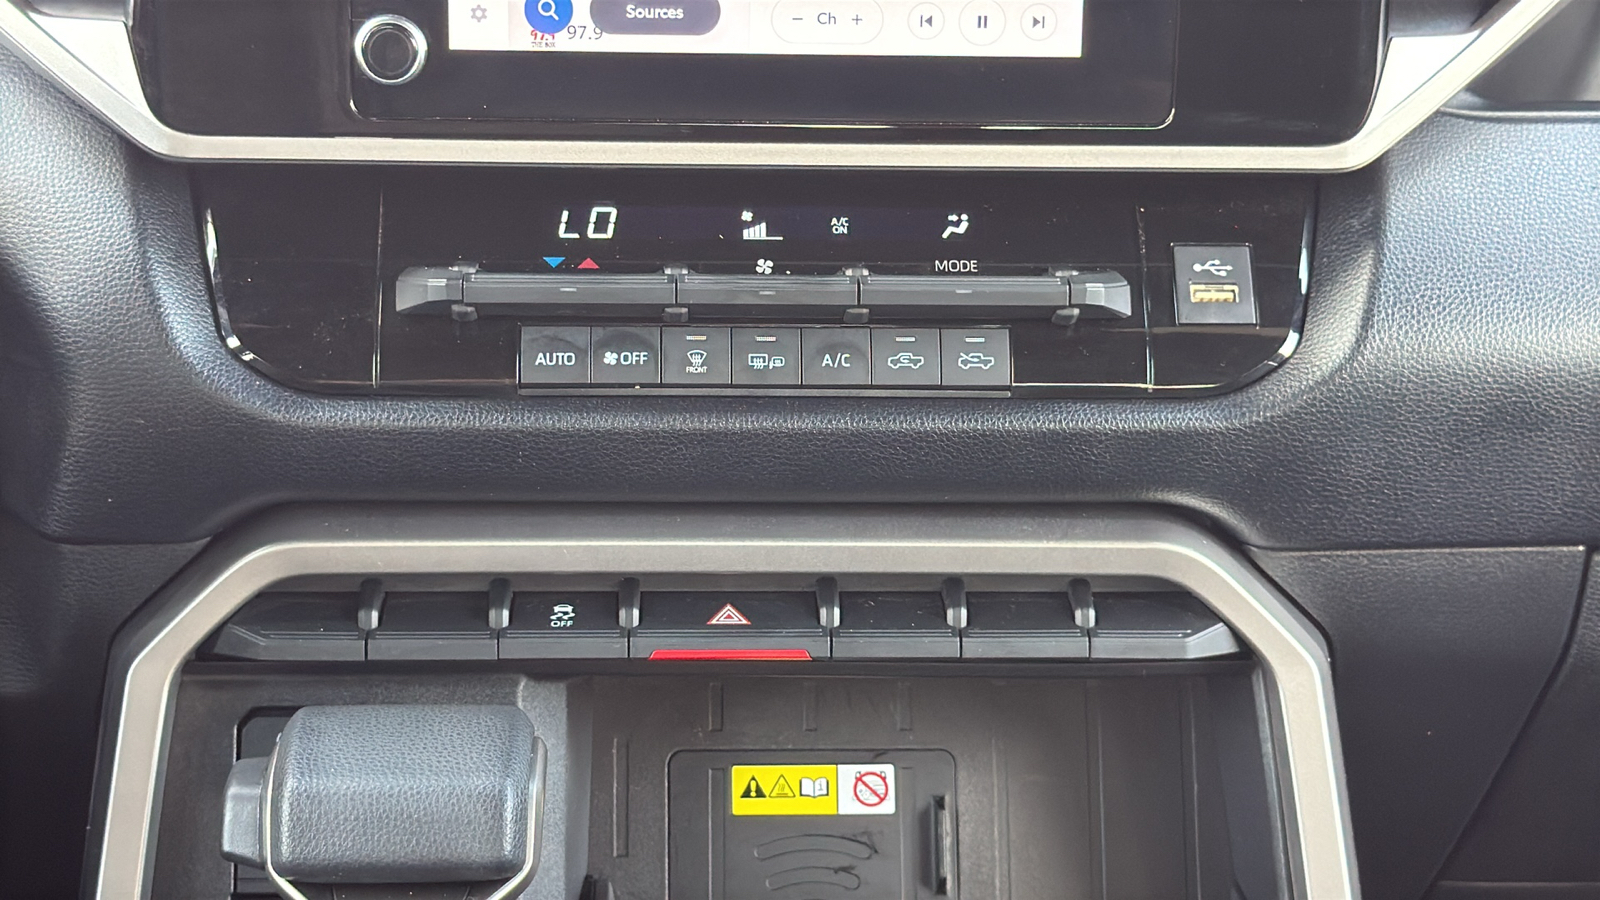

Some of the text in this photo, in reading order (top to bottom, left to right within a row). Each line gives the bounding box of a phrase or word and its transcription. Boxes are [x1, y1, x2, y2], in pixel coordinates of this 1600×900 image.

[626, 4, 684, 19] Sources
[817, 12, 837, 25] Ch
[567, 25, 603, 40] 97.9
[558, 206, 618, 239] LO
[831, 217, 849, 226] A/C
[832, 226, 848, 235] ON
[934, 260, 978, 273] MODE
[534, 353, 576, 366] AUTO
[620, 353, 648, 366] OFF
[821, 353, 851, 368] A/C
[686, 366, 708, 374] FRONT
[550, 620, 574, 628] OFF
